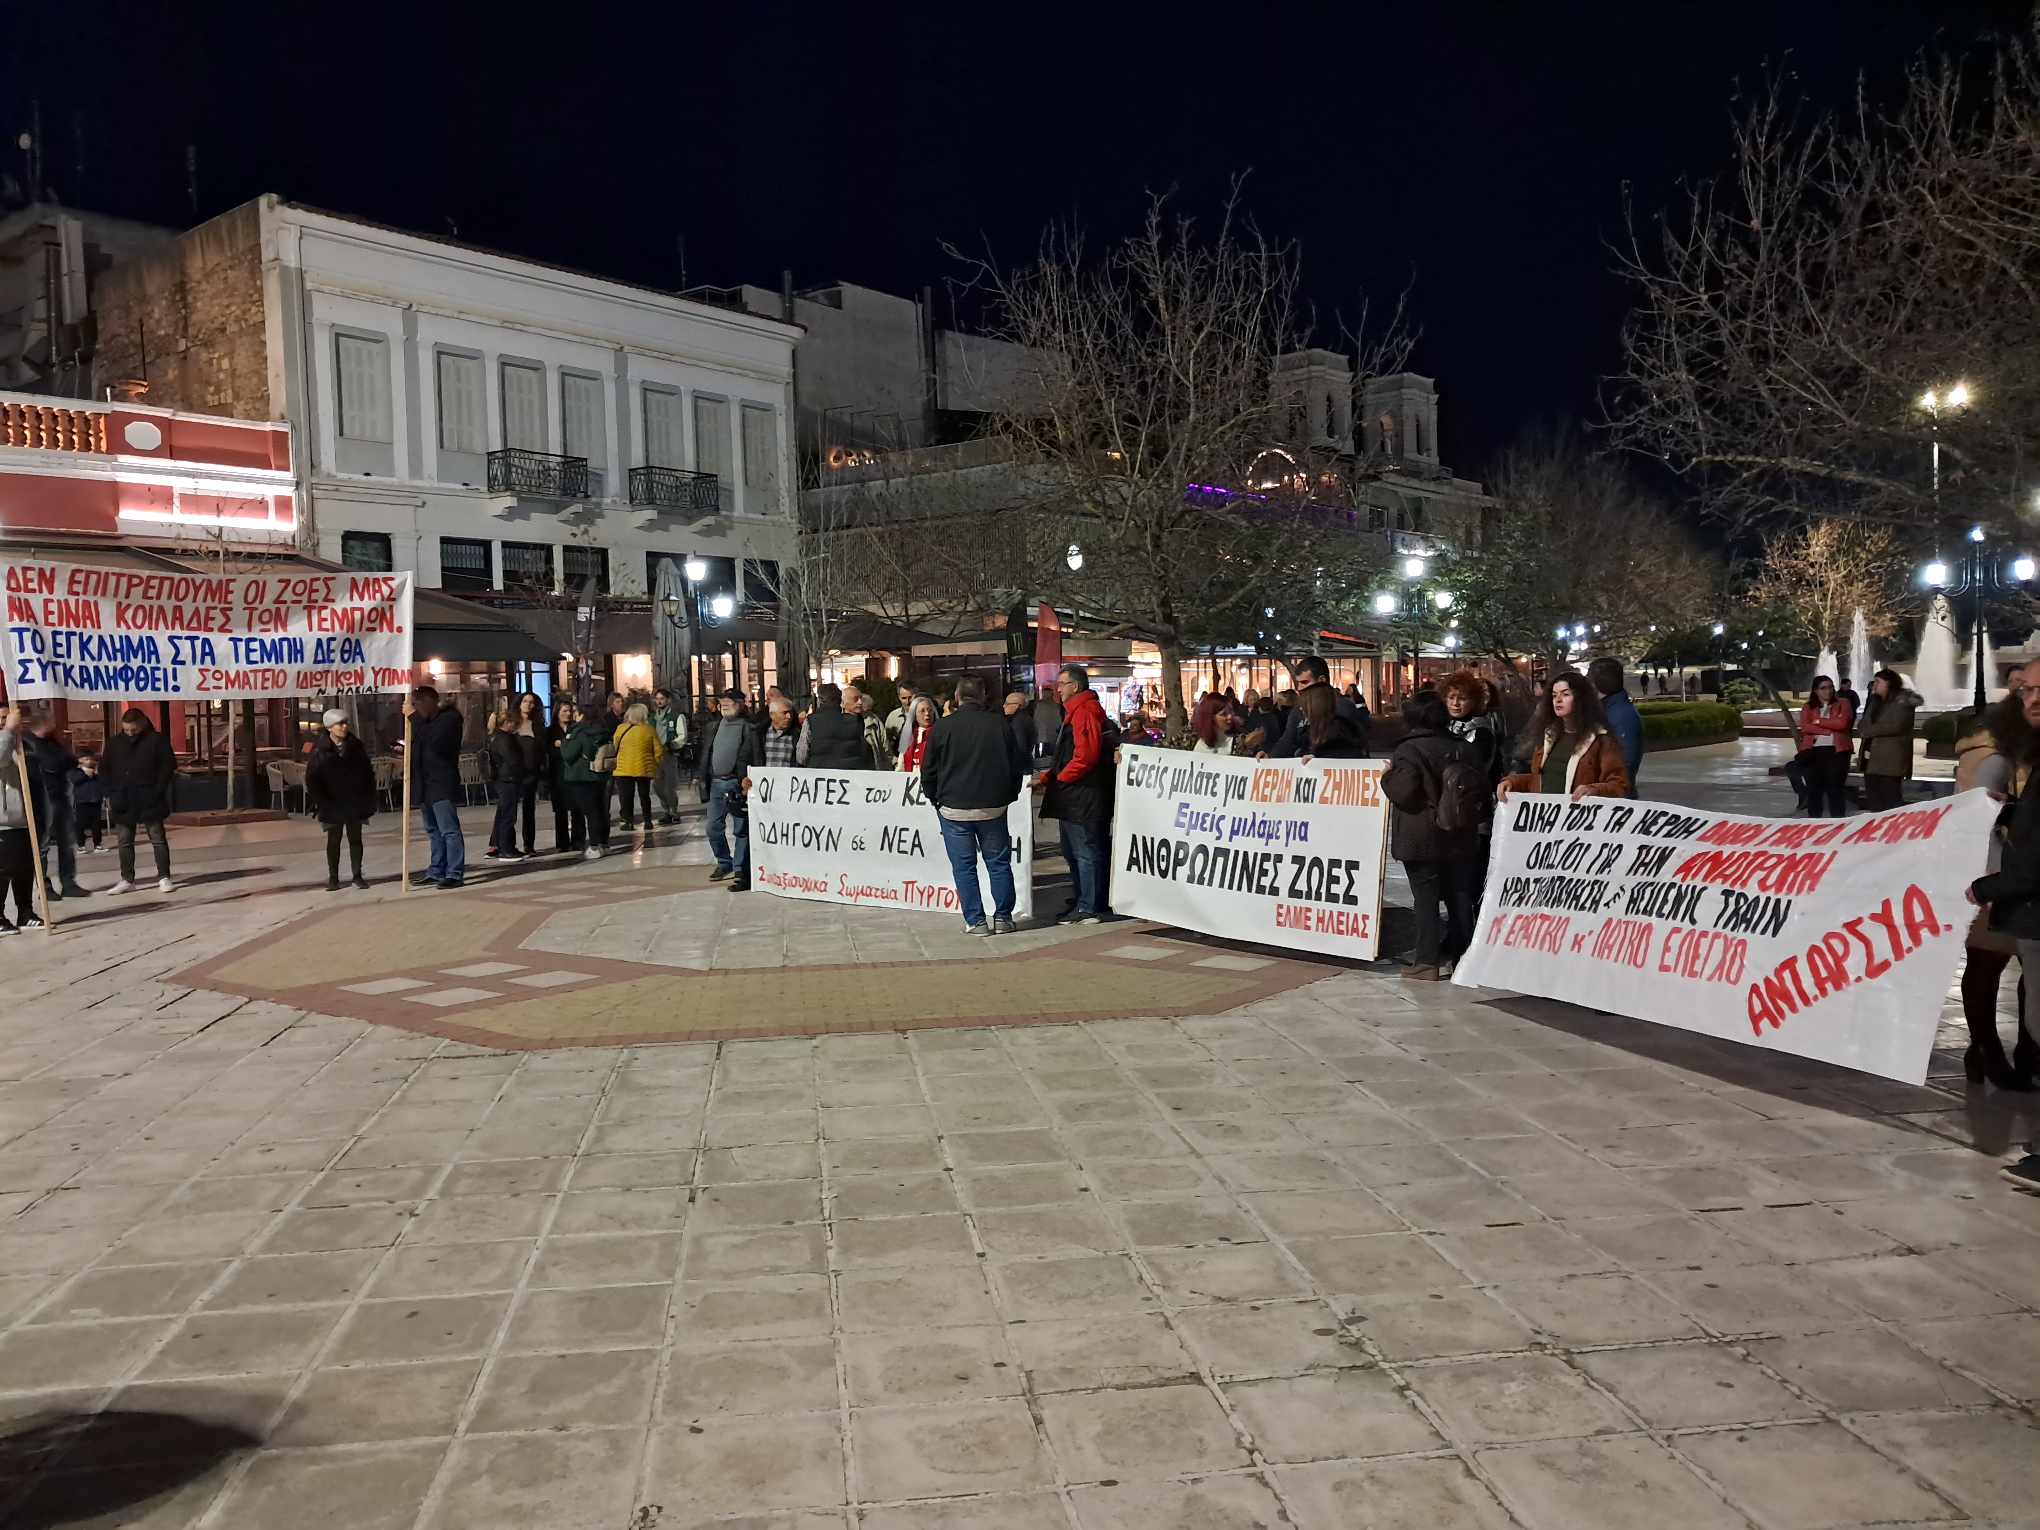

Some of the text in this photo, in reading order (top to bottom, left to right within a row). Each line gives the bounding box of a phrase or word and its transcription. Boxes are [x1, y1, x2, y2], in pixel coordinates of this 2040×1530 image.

[6, 566, 397, 605] ΔΕΝ ΕΠΙΤΡΕΠΟΥΜΕ ΟΙ ΖΩΕΣ ΜΑΣ
[7, 595, 38, 625] ΝΑ
[42, 598, 101, 629] ΕΙΝΑΙ
[115, 600, 233, 633] ΚΟΙΛΑΔΕΣ
[243, 606, 290, 633] ΤΩΝ
[9, 627, 365, 666] ΤΟ ΕΓΚΛΗΜΑ ΣΤΑ ΤΕΜΠΗ ΔΕ ΘΑ
[17, 658, 181, 692] ΣΥΓΚΑΛΗΦΘΕΙ!
[196, 667, 287, 691] ΣΩΜΑΤΕΙΟ
[296, 666, 364, 690] ΙΔΙΩΤΙΚΩΝ
[758, 776, 774, 803] ΟΙ
[789, 776, 850, 806] ΡΑΓΕΣ
[1126, 754, 1382, 808] Εσείς μιλάτε για ΚΕΡΔΗ και ΖΗΜΙΕΣ
[1174, 801, 1310, 847] Εμείς μιλάμε για
[1512, 801, 1561, 833] ΔΙΚΑ
[1560, 803, 1603, 832] ΤΟΥΣ
[1603, 805, 1634, 834] ΤΑ
[758, 821, 843, 852] ΟΔΗΓΟΥΝ
[880, 825, 925, 858] ΝΕΑ
[1126, 833, 1360, 906] ΑΝΘΡΩΠΙΝΕΣ ΖΩΕΣ
[1626, 844, 1677, 878] ΤΗΝ
[1672, 849, 1838, 896] ΑΝΑΤΡΟΠΗ
[1275, 903, 1370, 939] ΕΛΜΕ ΗΛΕΙΑΣ
[1713, 888, 1793, 938] TRAIN
[1659, 926, 1748, 986] ΕΛΕΓΧΟ
